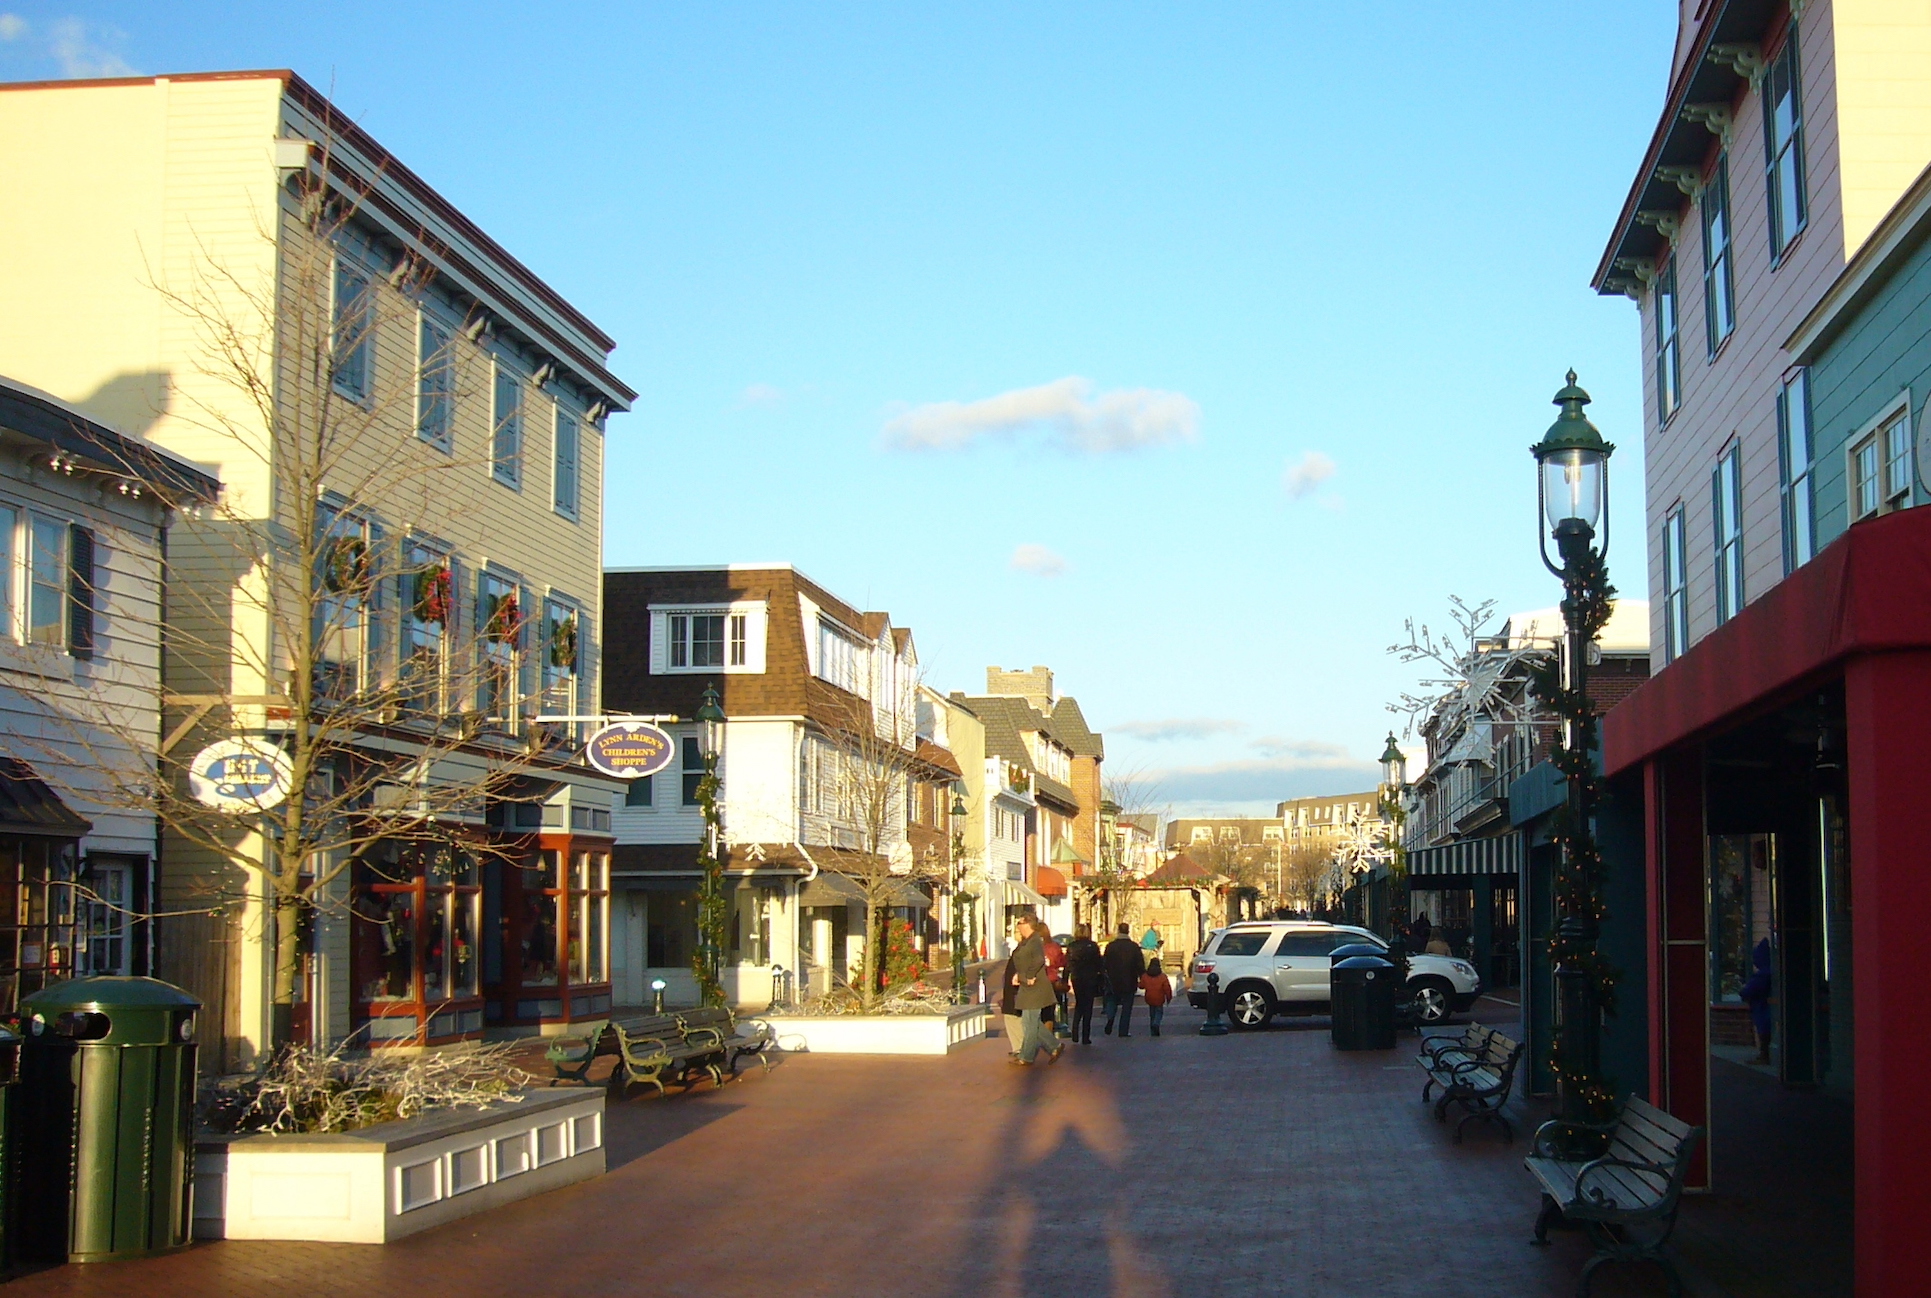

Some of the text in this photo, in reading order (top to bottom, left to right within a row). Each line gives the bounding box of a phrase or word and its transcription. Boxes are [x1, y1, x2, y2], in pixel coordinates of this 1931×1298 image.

[598, 733, 664, 749] LYNN ARDEN'S
[611, 758, 647, 766] SHOPPE
